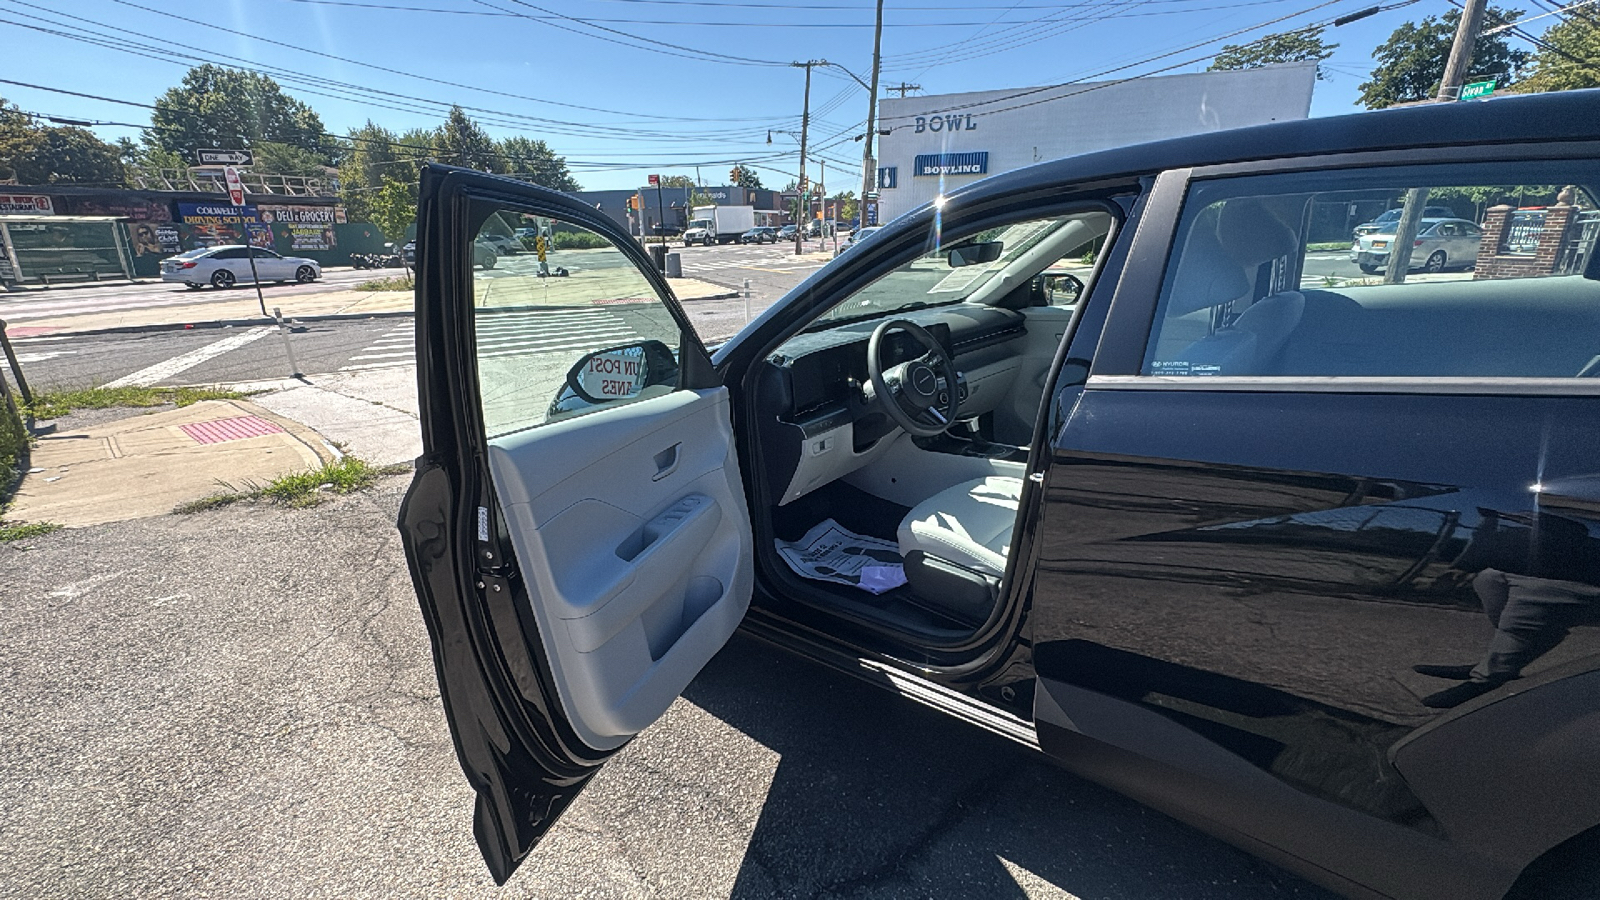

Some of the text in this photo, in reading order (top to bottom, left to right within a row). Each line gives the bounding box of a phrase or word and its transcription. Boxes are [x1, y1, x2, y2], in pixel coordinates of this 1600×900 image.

[914, 113, 977, 134] BOWL
[228, 154, 243, 162] WAY
[924, 165, 981, 174] BOWLING
[184, 216, 222, 224] DRIVING
[277, 210, 293, 222] DELI
[300, 211, 334, 222] GROCERY
